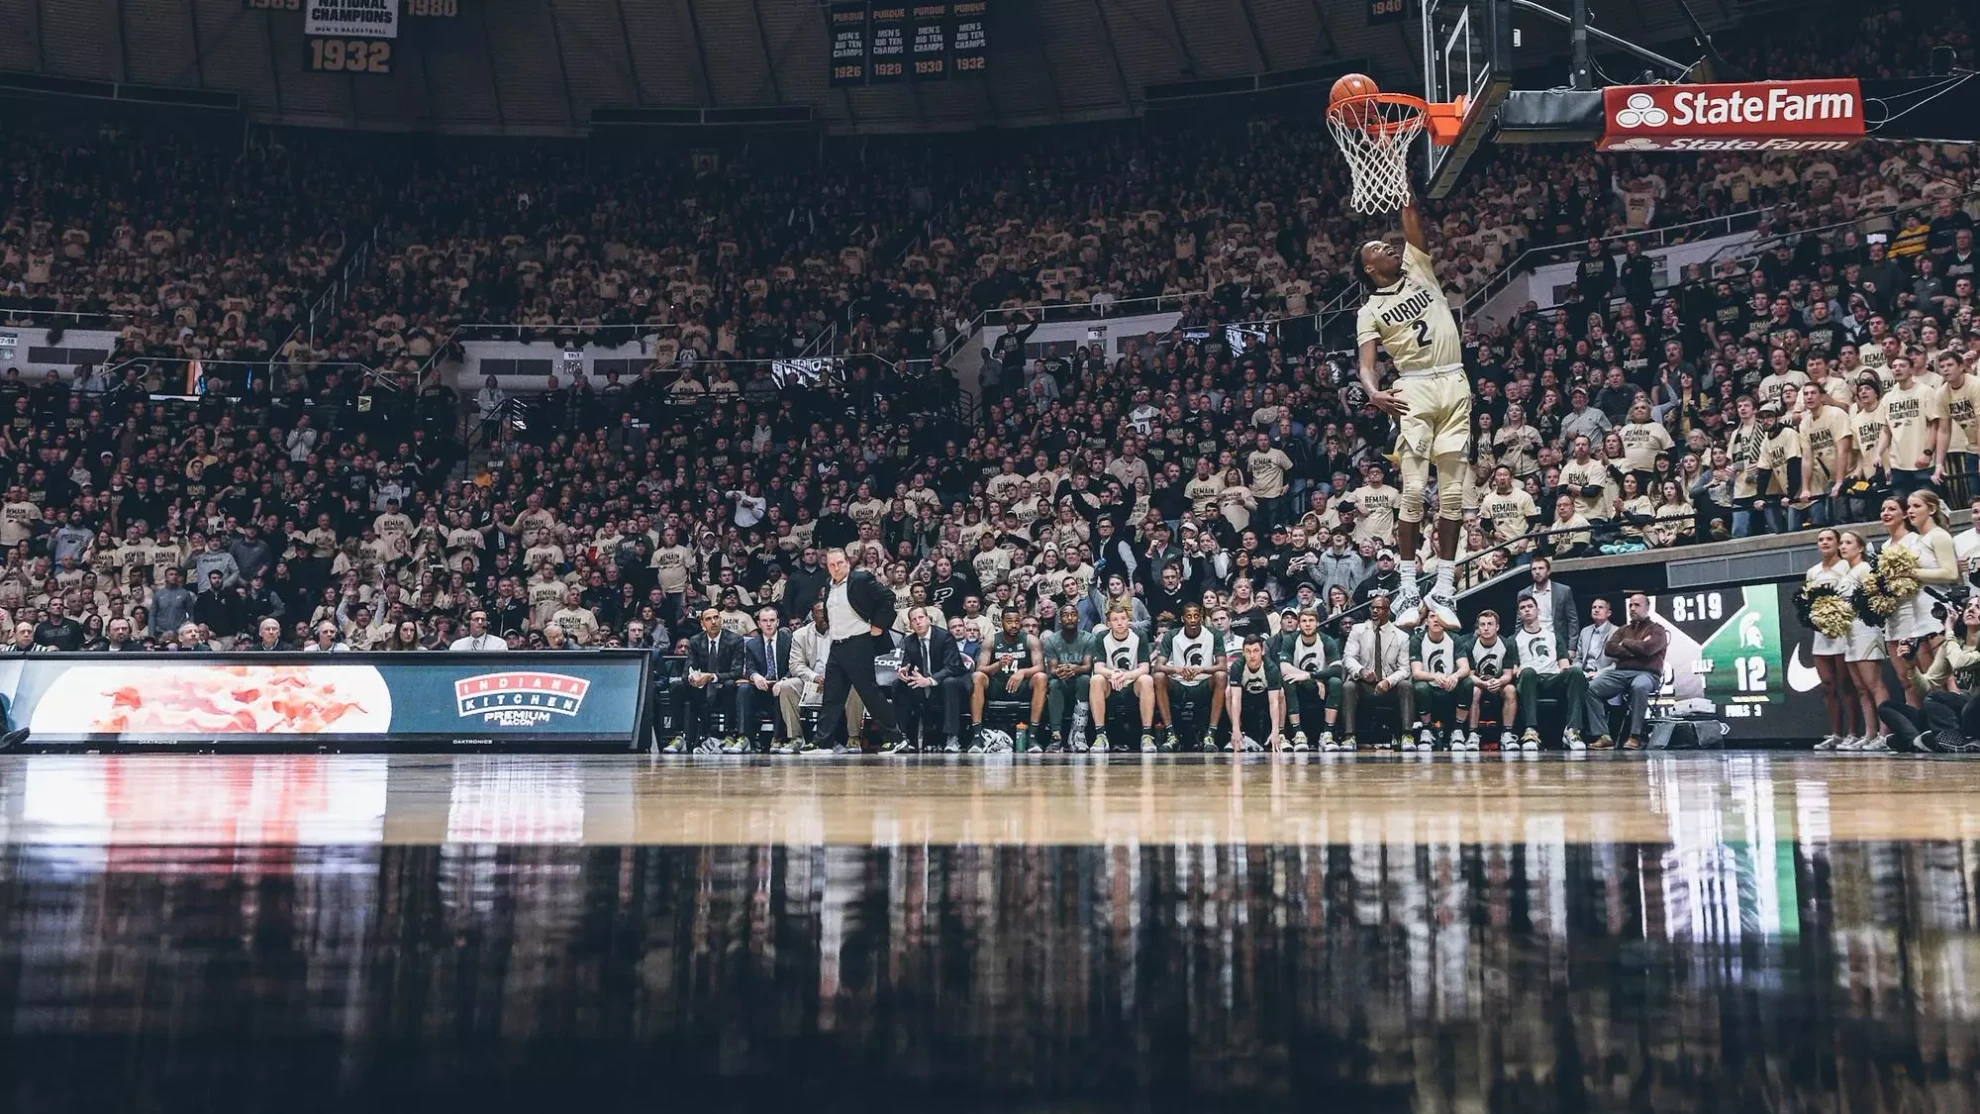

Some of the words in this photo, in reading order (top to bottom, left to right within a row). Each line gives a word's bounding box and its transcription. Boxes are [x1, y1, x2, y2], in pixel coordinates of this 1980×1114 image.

[913, 5, 946, 16] PURDUE
[954, 2, 985, 13] PURDUE
[311, 9, 393, 24] CHAMPIONS
[833, 11, 864, 22] PURDUE
[873, 8, 905, 19] PURDUE
[929, 34, 943, 42] TEN
[970, 30, 984, 39] TEN
[848, 40, 862, 49] TEN
[888, 37, 902, 45] TEN
[955, 39, 986, 49] CHAMPS
[833, 49, 863, 58] CHAMPS
[873, 46, 903, 55] CHAMPS
[914, 43, 944, 53] CHAMPS
[311, 39, 390, 73] 1932
[915, 60, 943, 74] 1930
[956, 57, 985, 70] 1932
[834, 66, 862, 79] 1926
[875, 63, 902, 76] 1928
[1381, 289, 1434, 327] PURDUE
[1412, 319, 1433, 349] 2
[1889, 399, 1919, 413] REMAIN
[1625, 429, 1651, 437] REMAIN
[1193, 487, 1214, 495] REMAIN
[1365, 495, 1388, 503] REMAIN
[1492, 503, 1518, 513] REMAIN
[1672, 592, 1723, 622] 8:19
[560, 617, 581, 625] REMAIN
[1734, 655, 1768, 692] 12
[464, 677, 580, 694] INDIANA
[465, 693, 574, 711] KITCHEN
[484, 710, 551, 723] PREMIUM
[500, 719, 535, 728] BACON
